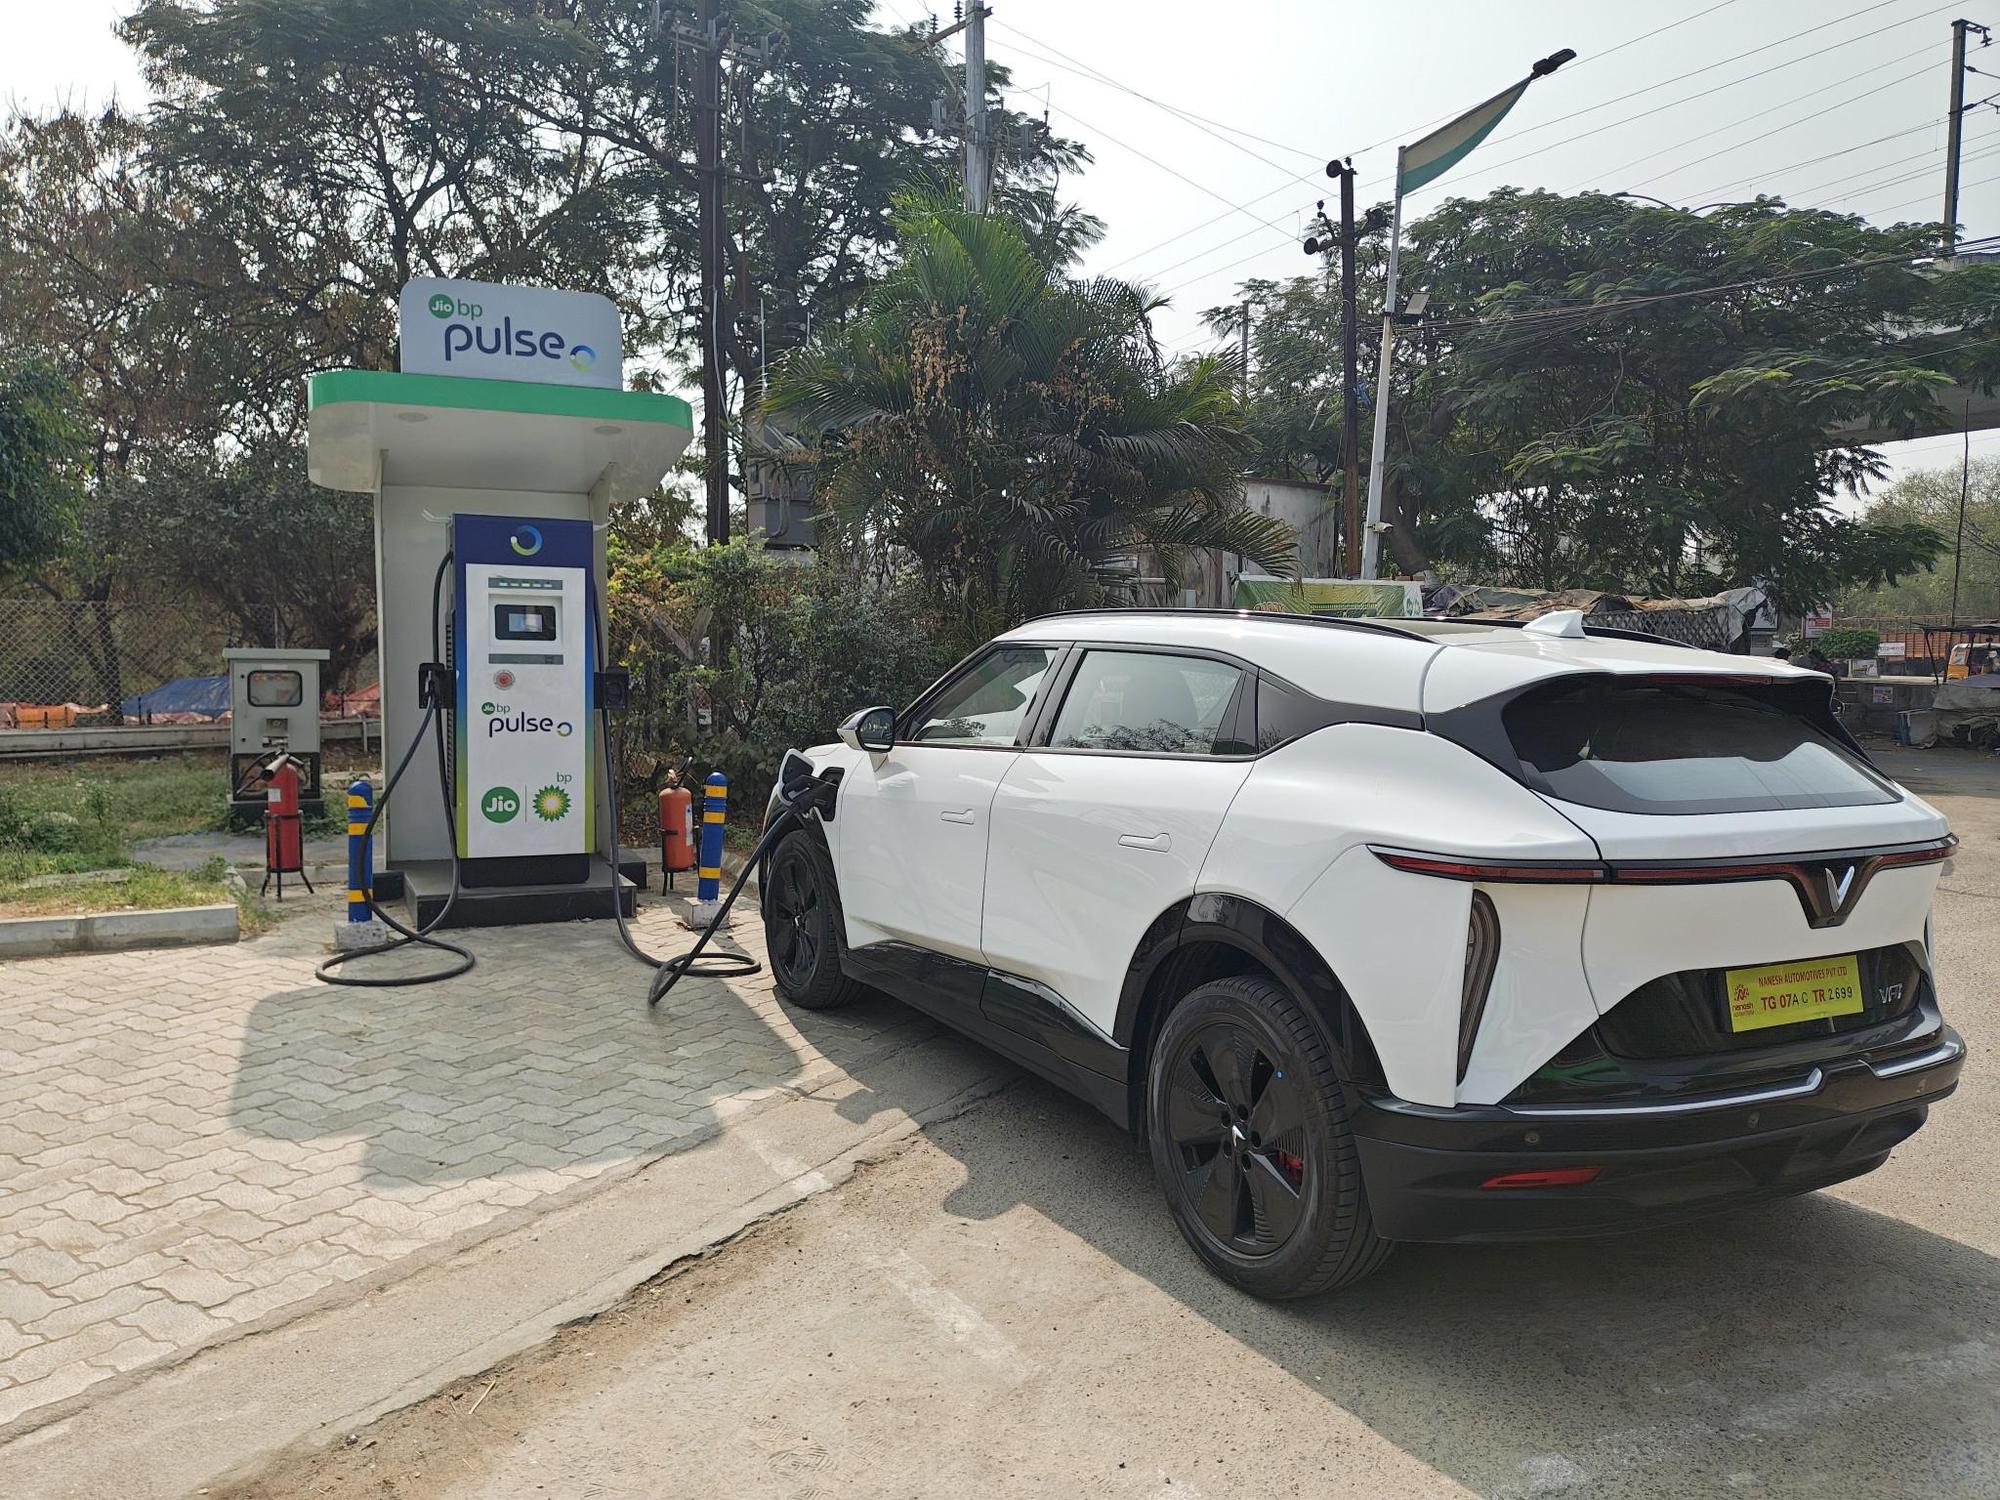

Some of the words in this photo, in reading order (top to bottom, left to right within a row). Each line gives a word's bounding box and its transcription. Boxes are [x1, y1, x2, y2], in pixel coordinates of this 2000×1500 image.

[431, 300, 452, 312] Jio
[457, 298, 483, 320] bp
[444, 316, 565, 361] pulse
[496, 703, 511, 714] bp
[489, 711, 553, 738] pulse
[556, 772, 572, 785] bp
[486, 796, 516, 812] Jio
[1784, 969, 1825, 984] AUTOMOTIVES
[1826, 967, 1836, 977] PVT
[1837, 966, 1848, 976] LTD
[1760, 996, 1777, 1010] TG
[1812, 989, 1826, 1003] TR
